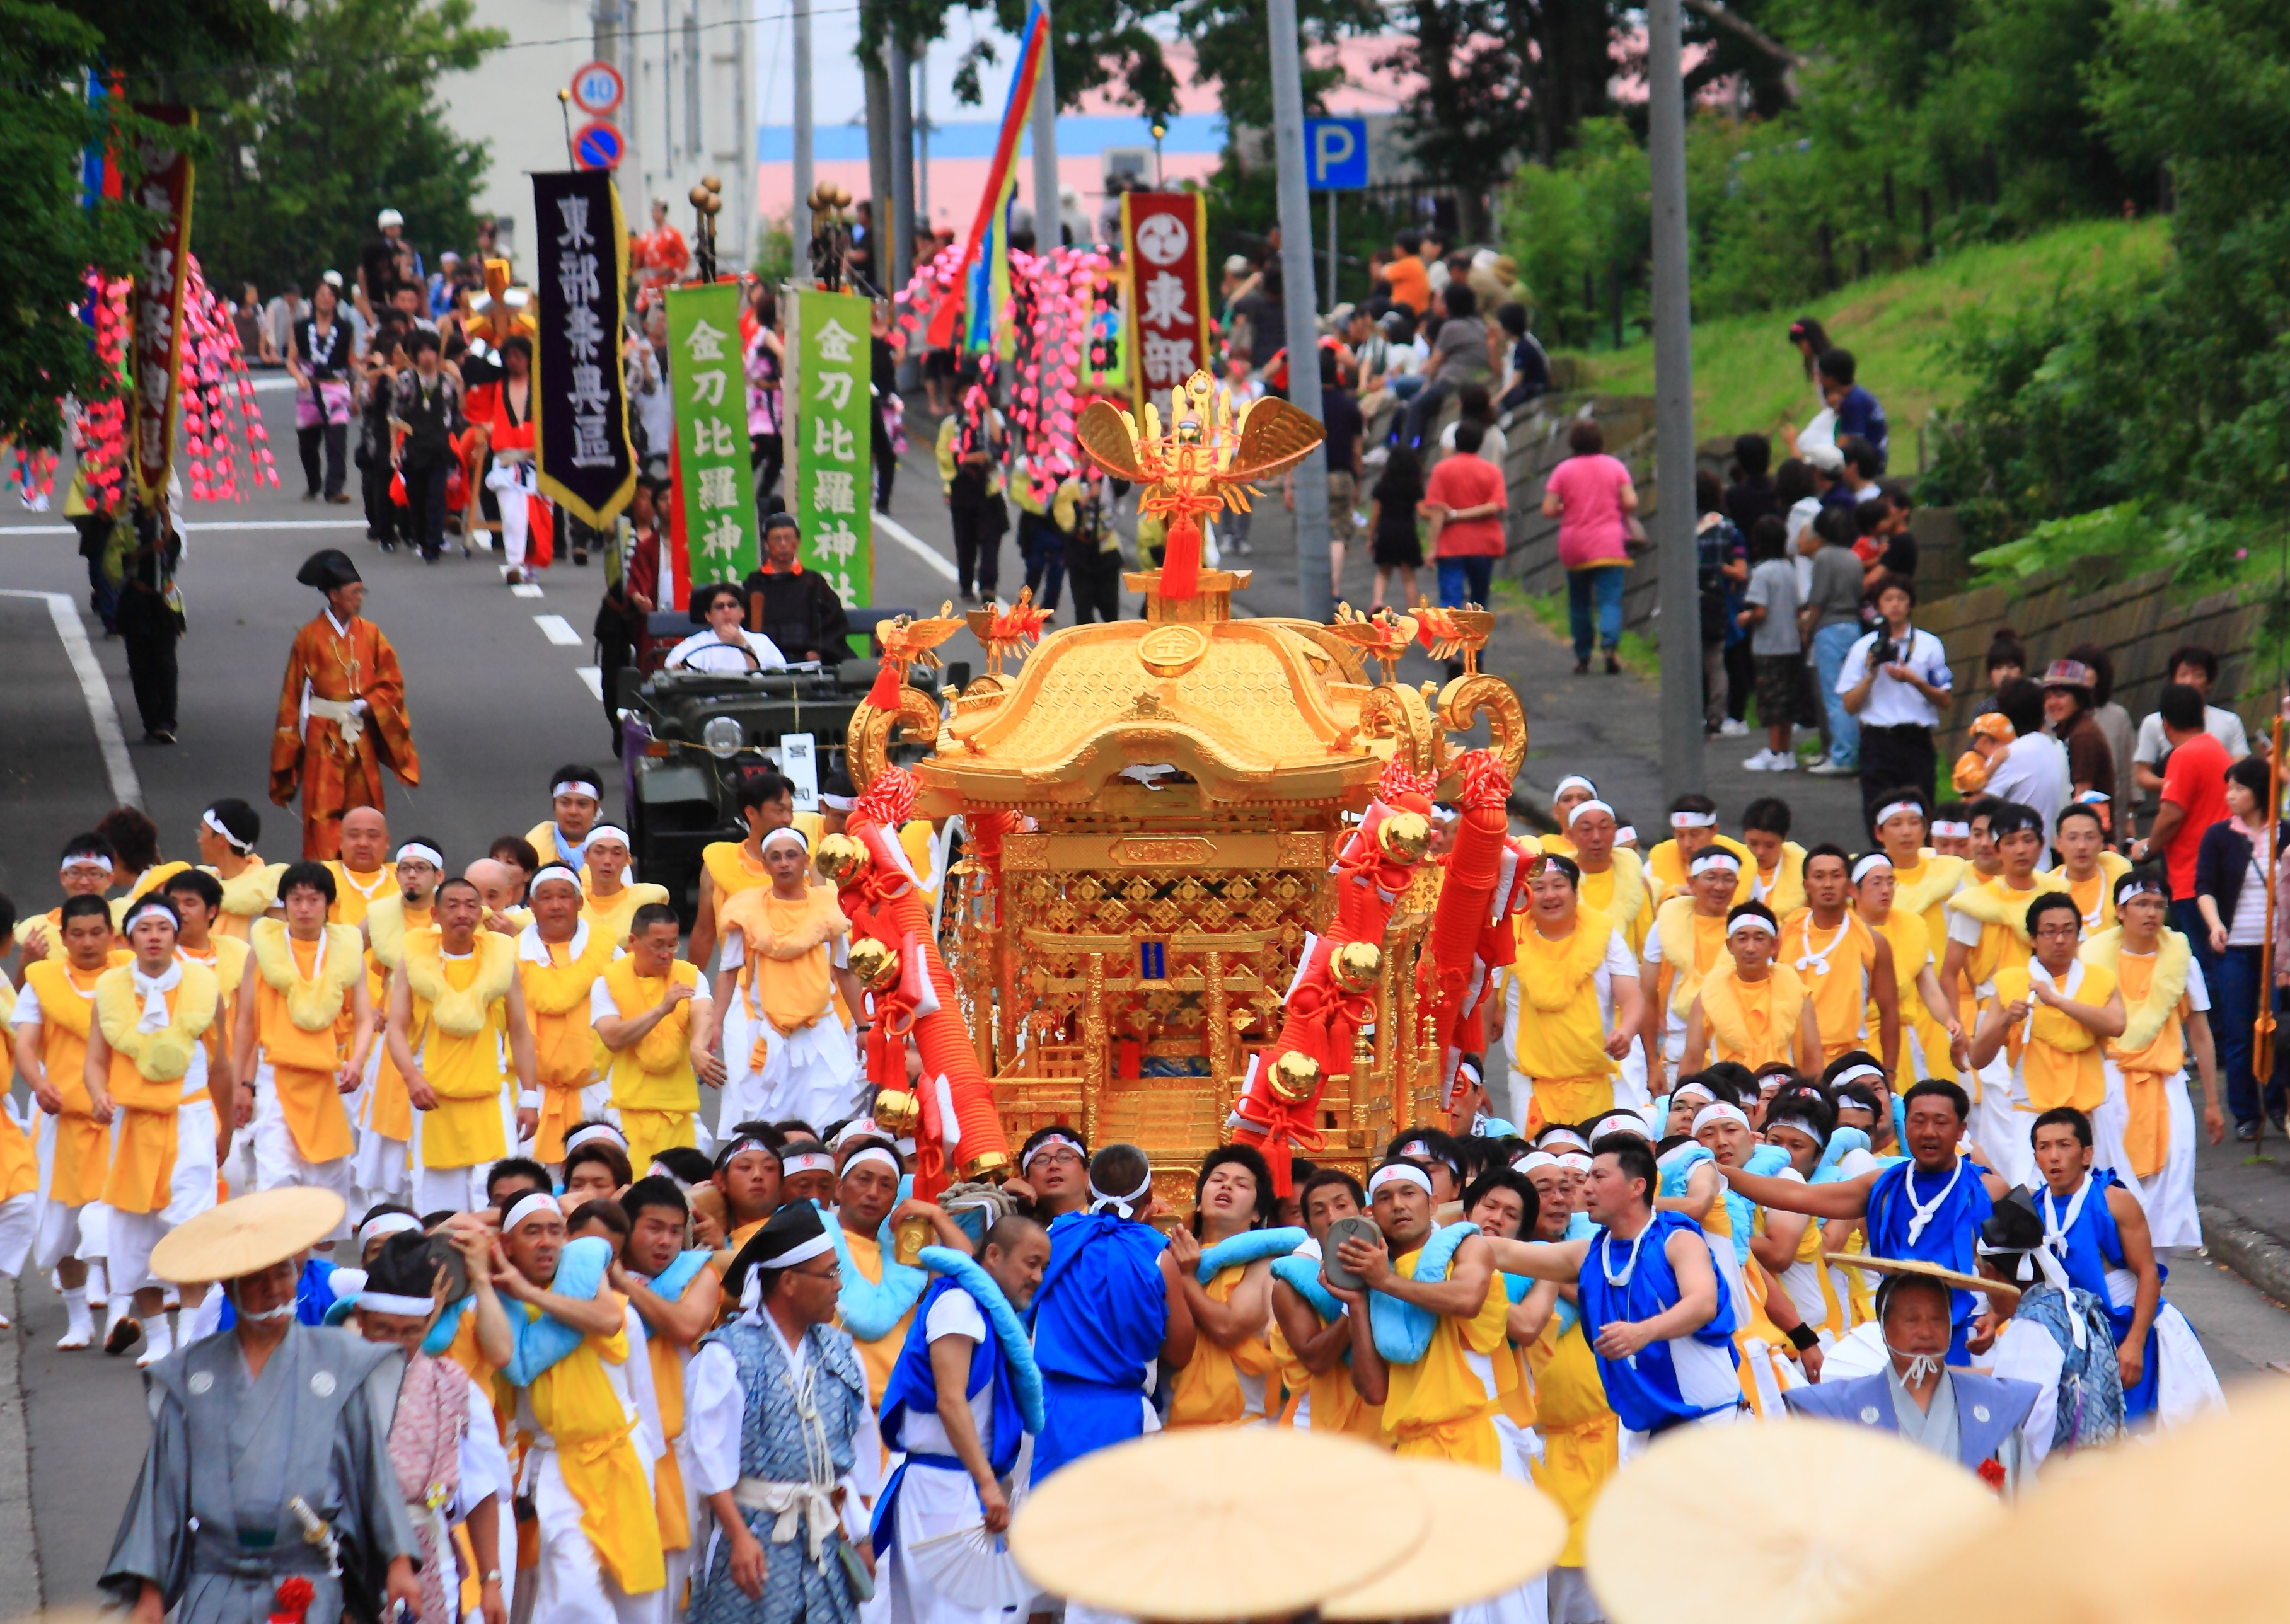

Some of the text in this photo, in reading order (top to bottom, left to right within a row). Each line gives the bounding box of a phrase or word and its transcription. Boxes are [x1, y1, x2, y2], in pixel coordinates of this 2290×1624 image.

[583, 76, 614, 102] 40
[1316, 125, 1355, 181] P
[1147, 630, 1196, 659] 金
